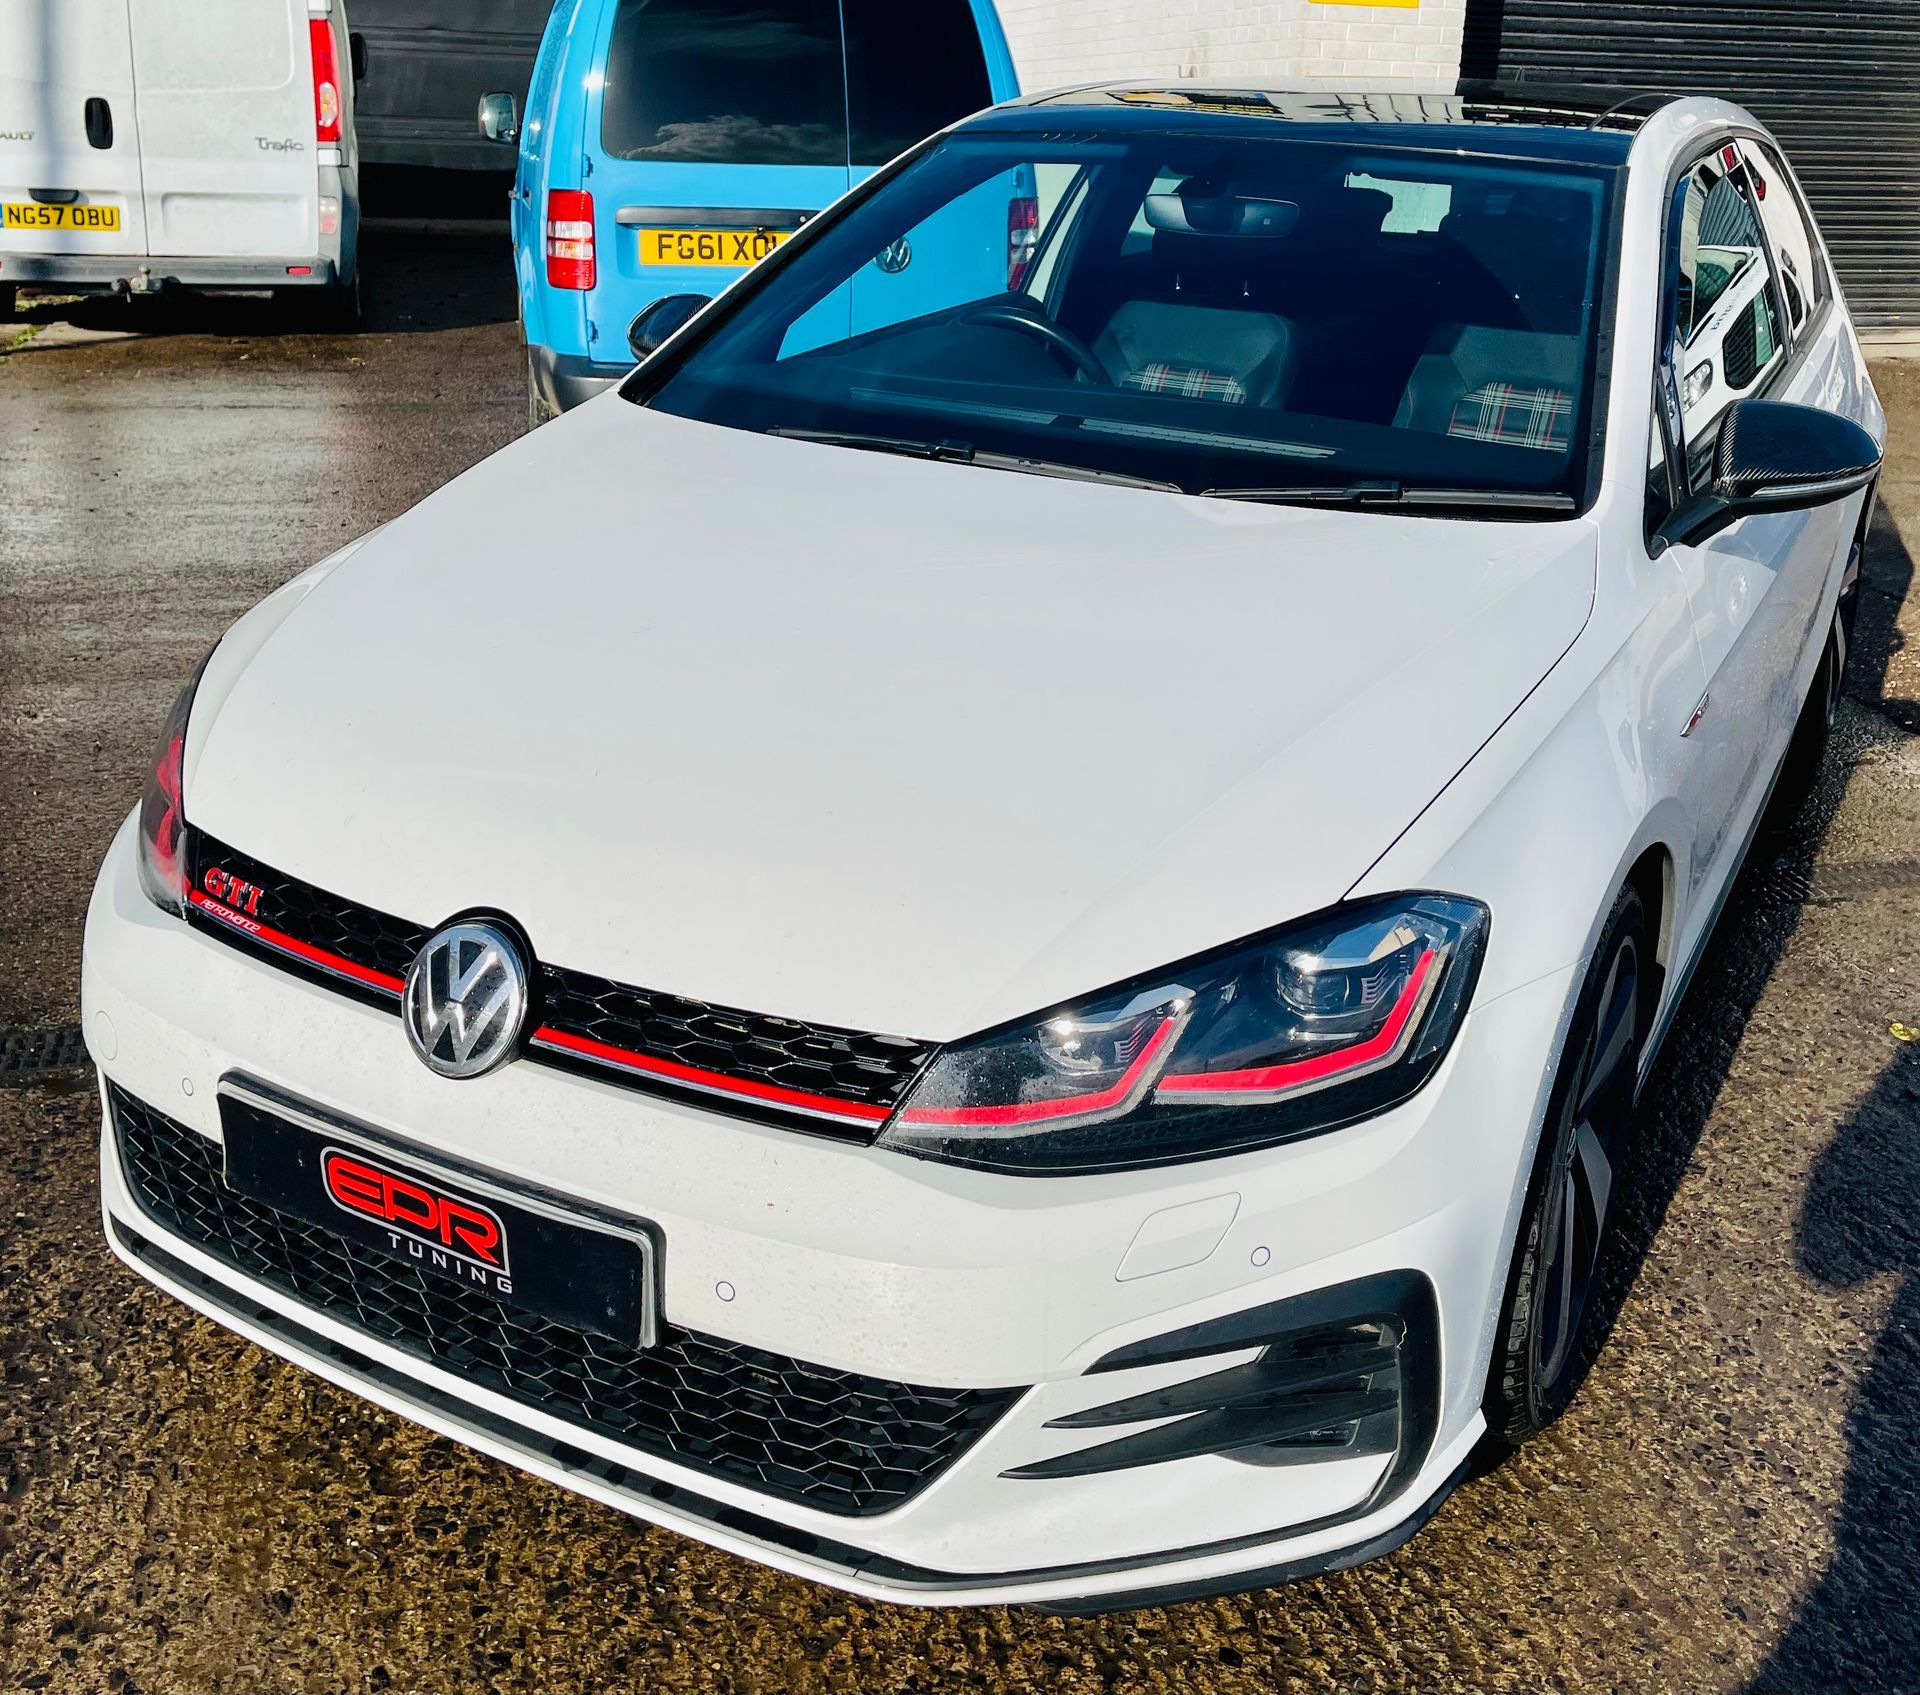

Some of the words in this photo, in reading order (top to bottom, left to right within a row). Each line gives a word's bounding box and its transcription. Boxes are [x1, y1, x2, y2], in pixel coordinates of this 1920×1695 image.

[8, 206, 65, 225] NG57
[72, 208, 114, 226] OBU
[657, 233, 723, 260] FG61
[204, 867, 264, 916] GTI
[328, 1156, 499, 1265] EPR
[387, 1232, 513, 1294] TUNING
